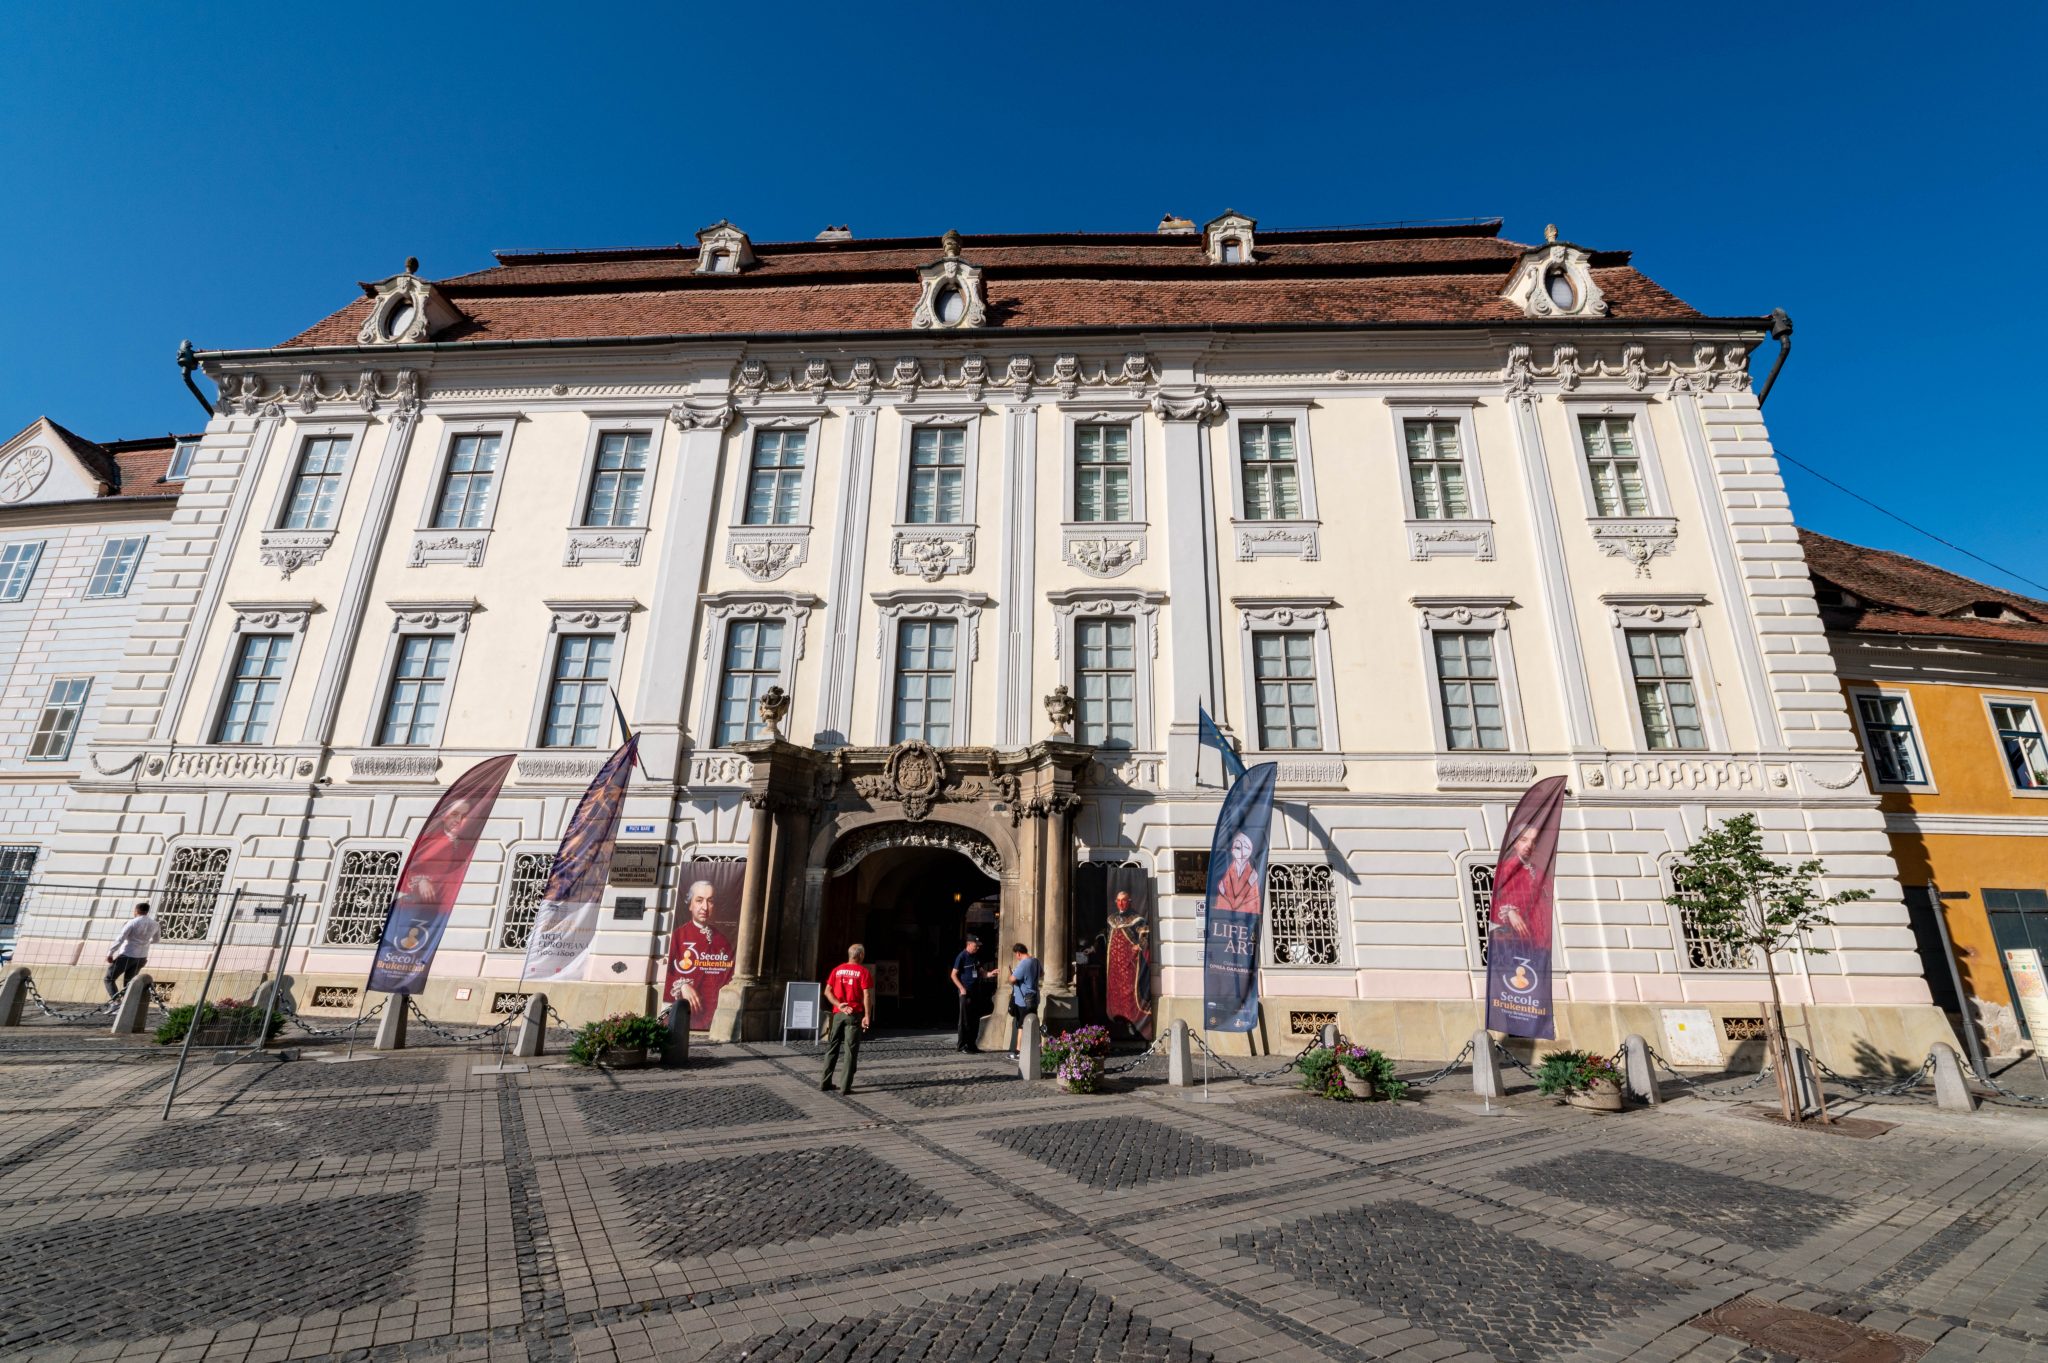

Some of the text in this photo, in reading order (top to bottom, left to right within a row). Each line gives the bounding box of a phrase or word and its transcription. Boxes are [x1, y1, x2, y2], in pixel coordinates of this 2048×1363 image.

[1213, 922, 1248, 940] LIFE
[1224, 940, 1257, 956] ART
[700, 952, 728, 960] Secole
[376, 960, 426, 972] Brukenthal
[1493, 998, 1546, 1015] Brukenthal
[1501, 992, 1539, 1006] Secole
